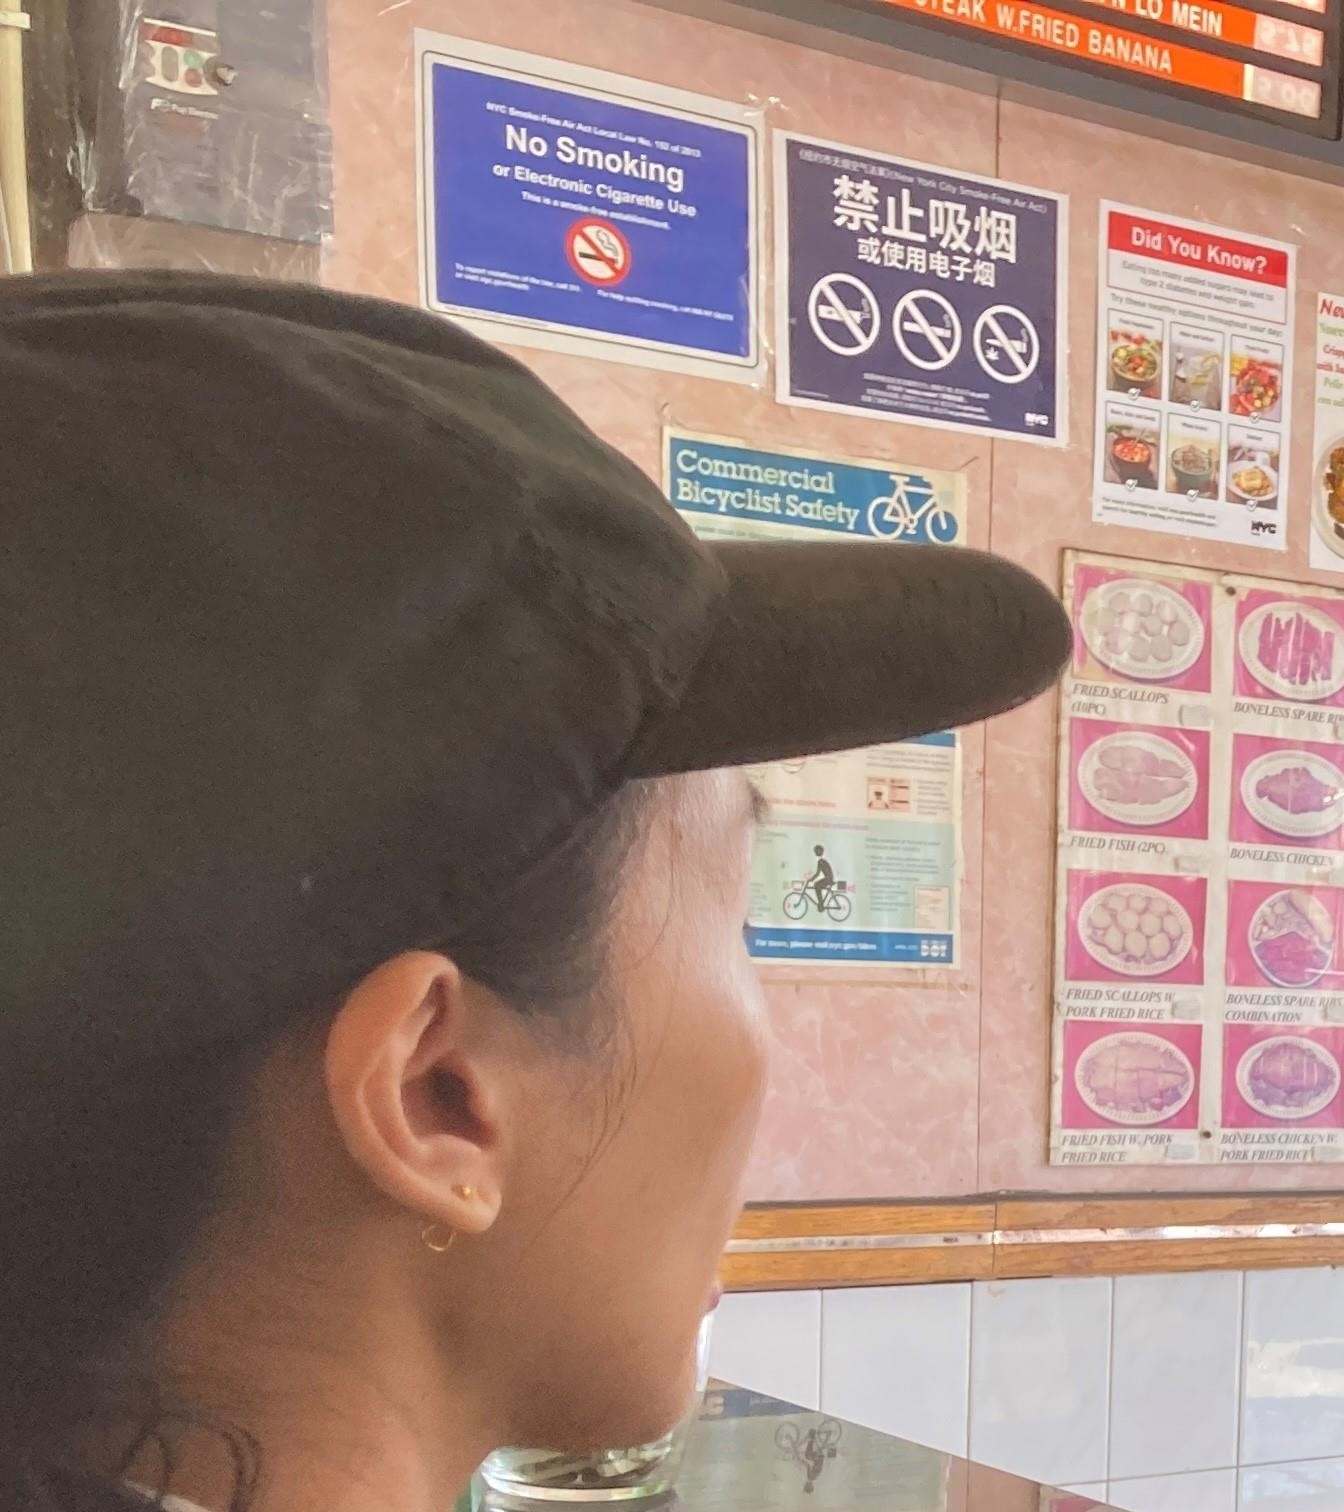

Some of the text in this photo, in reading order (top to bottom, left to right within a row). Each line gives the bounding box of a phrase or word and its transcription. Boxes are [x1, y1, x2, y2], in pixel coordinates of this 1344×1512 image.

[1135, 0, 1223, 36] LO MEIN
[996, 5, 1080, 48] W.FRIED
[1087, 30, 1173, 74] BANANA
[505, 124, 685, 193] No Smoking
[493, 164, 697, 218] or Electronic Cigarette Use
[832, 174, 1017, 263] 禁止吸烟
[1131, 226, 1268, 275] Did You Know?
[857, 237, 996, 288] 或使用电子烟
[676, 449, 835, 494] Commercial
[676, 477, 860, 530] Bicyclist Safety
[1251, 520, 1277, 535] NYC
[1072, 683, 1170, 704] FRIED SCALLOPS
[1233, 701, 1326, 722] BONELESS SPARE
[1069, 835, 1106, 850] FRIED
[1107, 838, 1136, 852] FISH
[1229, 847, 1335, 866] BONELESS CHICKEN
[1066, 988, 1160, 1003] FRIED SCALLOPS
[1226, 993, 1317, 1008] BONELESS SPARE
[1065, 1006, 1164, 1021] PORK FRIED RICE
[1225, 1008, 1302, 1023] COMBINATION
[1061, 1134, 1098, 1146] FRIED
[1099, 1134, 1127, 1146] FISH
[1142, 1134, 1175, 1145] PORK
[1220, 1134, 1277, 1145] BONELESS
[1278, 1134, 1326, 1146] CHICKEN
[1061, 1151, 1127, 1163] FRIED RICE
[1220, 1149, 1251, 1162] PORK
[1251, 1150, 1285, 1162] FRIED
